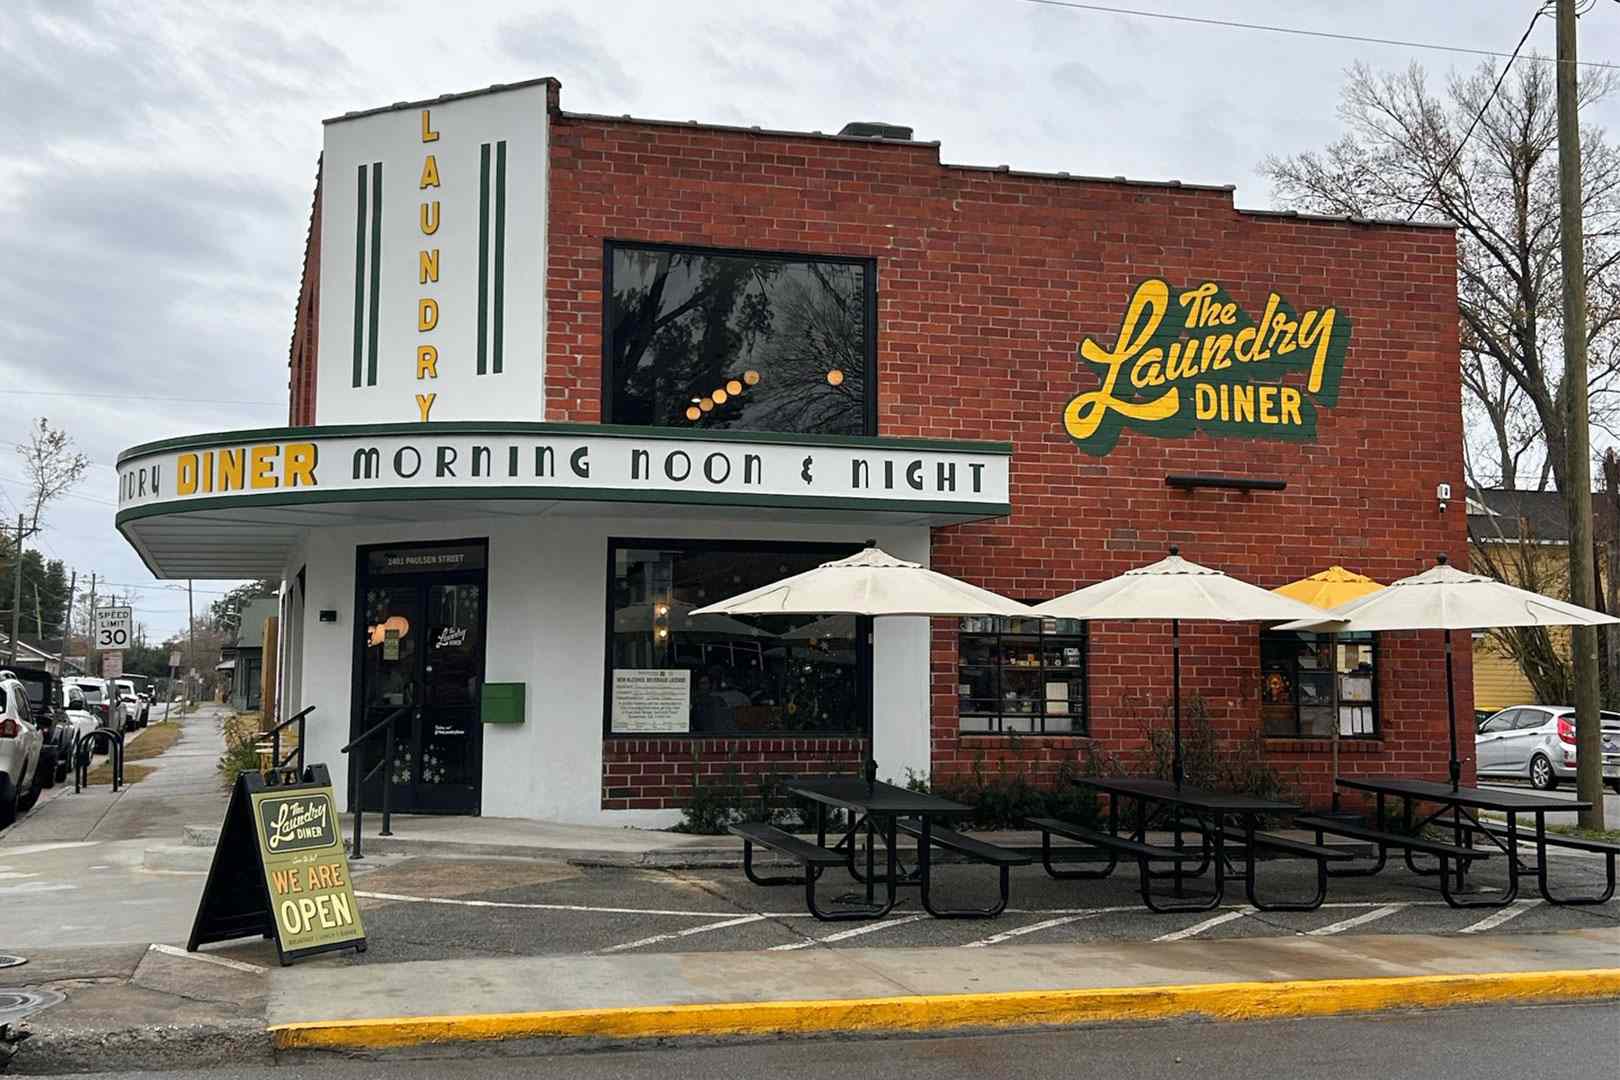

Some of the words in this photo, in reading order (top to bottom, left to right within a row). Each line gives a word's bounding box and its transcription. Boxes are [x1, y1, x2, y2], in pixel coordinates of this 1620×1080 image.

[415, 110, 440, 423] LAUNDRY
[1179, 282, 1237, 328] The
[1064, 279, 1336, 440] Laundry
[1195, 383, 1302, 425] DINER
[177, 442, 318, 496] DINER
[352, 446, 590, 479] MORNING
[631, 449, 762, 484] NOON
[801, 455, 814, 485] &
[852, 459, 985, 493] NIGHT
[438, 553, 464, 563] STREET
[98, 611, 129, 619] SPEED
[101, 620, 124, 628] LIMIT
[100, 629, 127, 645] 30
[269, 802, 327, 848] Laundry
[290, 802, 304, 815] The
[297, 826, 322, 840] DINER
[272, 869, 303, 896] WE
[308, 863, 345, 892] ARE
[281, 892, 353, 936] OPEN
